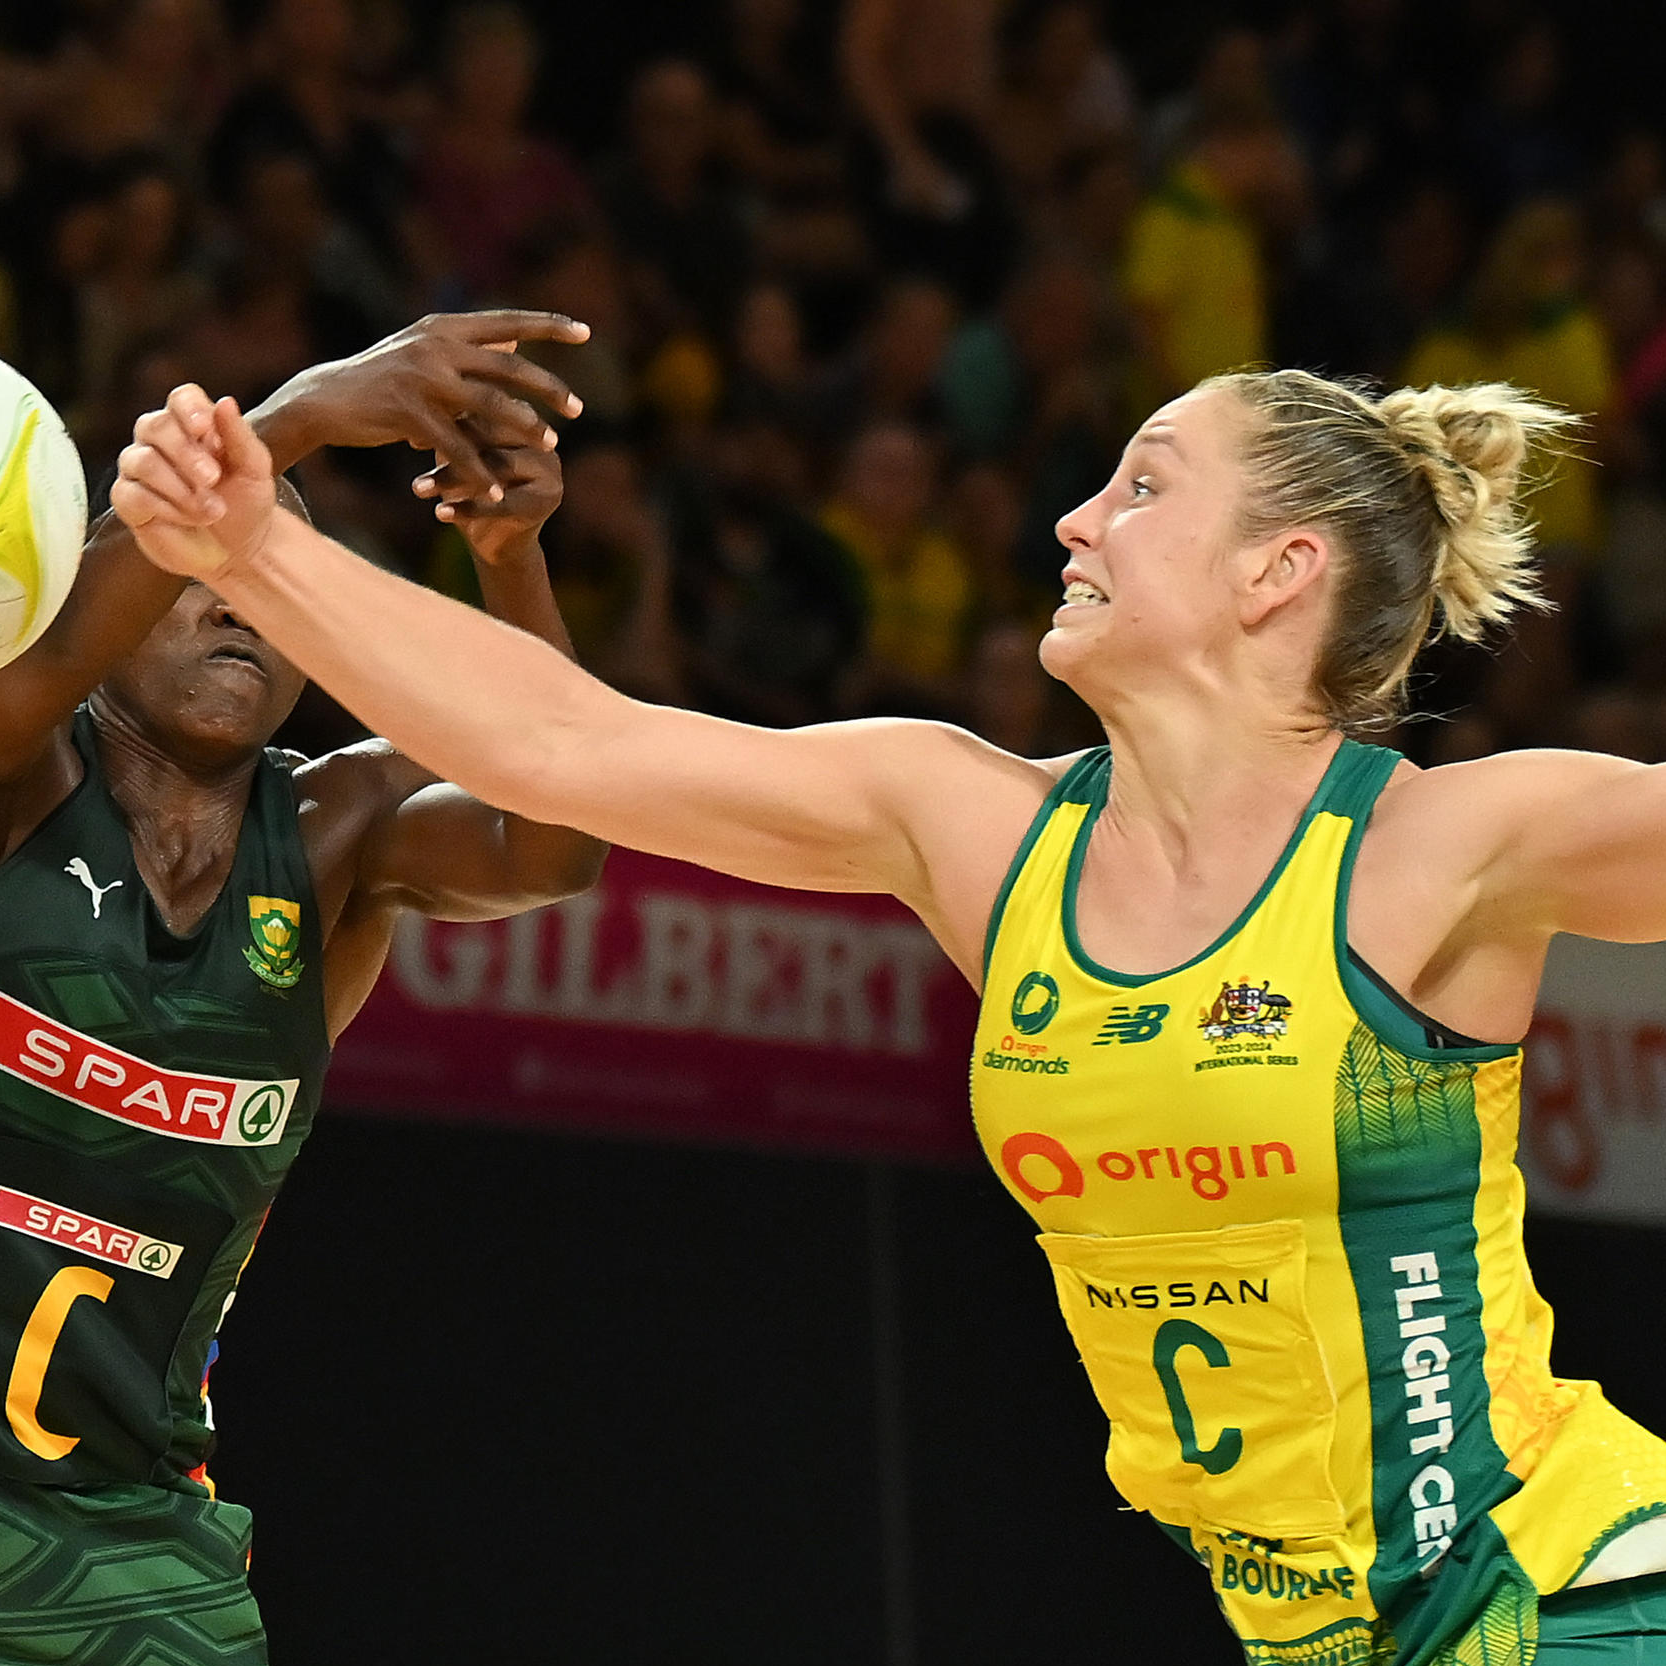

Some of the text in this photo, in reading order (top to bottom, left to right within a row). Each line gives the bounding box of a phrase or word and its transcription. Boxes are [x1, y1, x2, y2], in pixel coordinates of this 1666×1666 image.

[391, 888, 951, 1056] GILBERT
[19, 1028, 228, 1130] SPAR
[983, 1048, 1070, 1075] diamonds
[1097, 1141, 1297, 1201] origin
[25, 1204, 136, 1260] SPAR
[1086, 1278, 1270, 1309] NISSAN
[5, 1265, 115, 1462] C
[1153, 1318, 1244, 1476] C
[1390, 1251, 1457, 1456] FLIGHT
